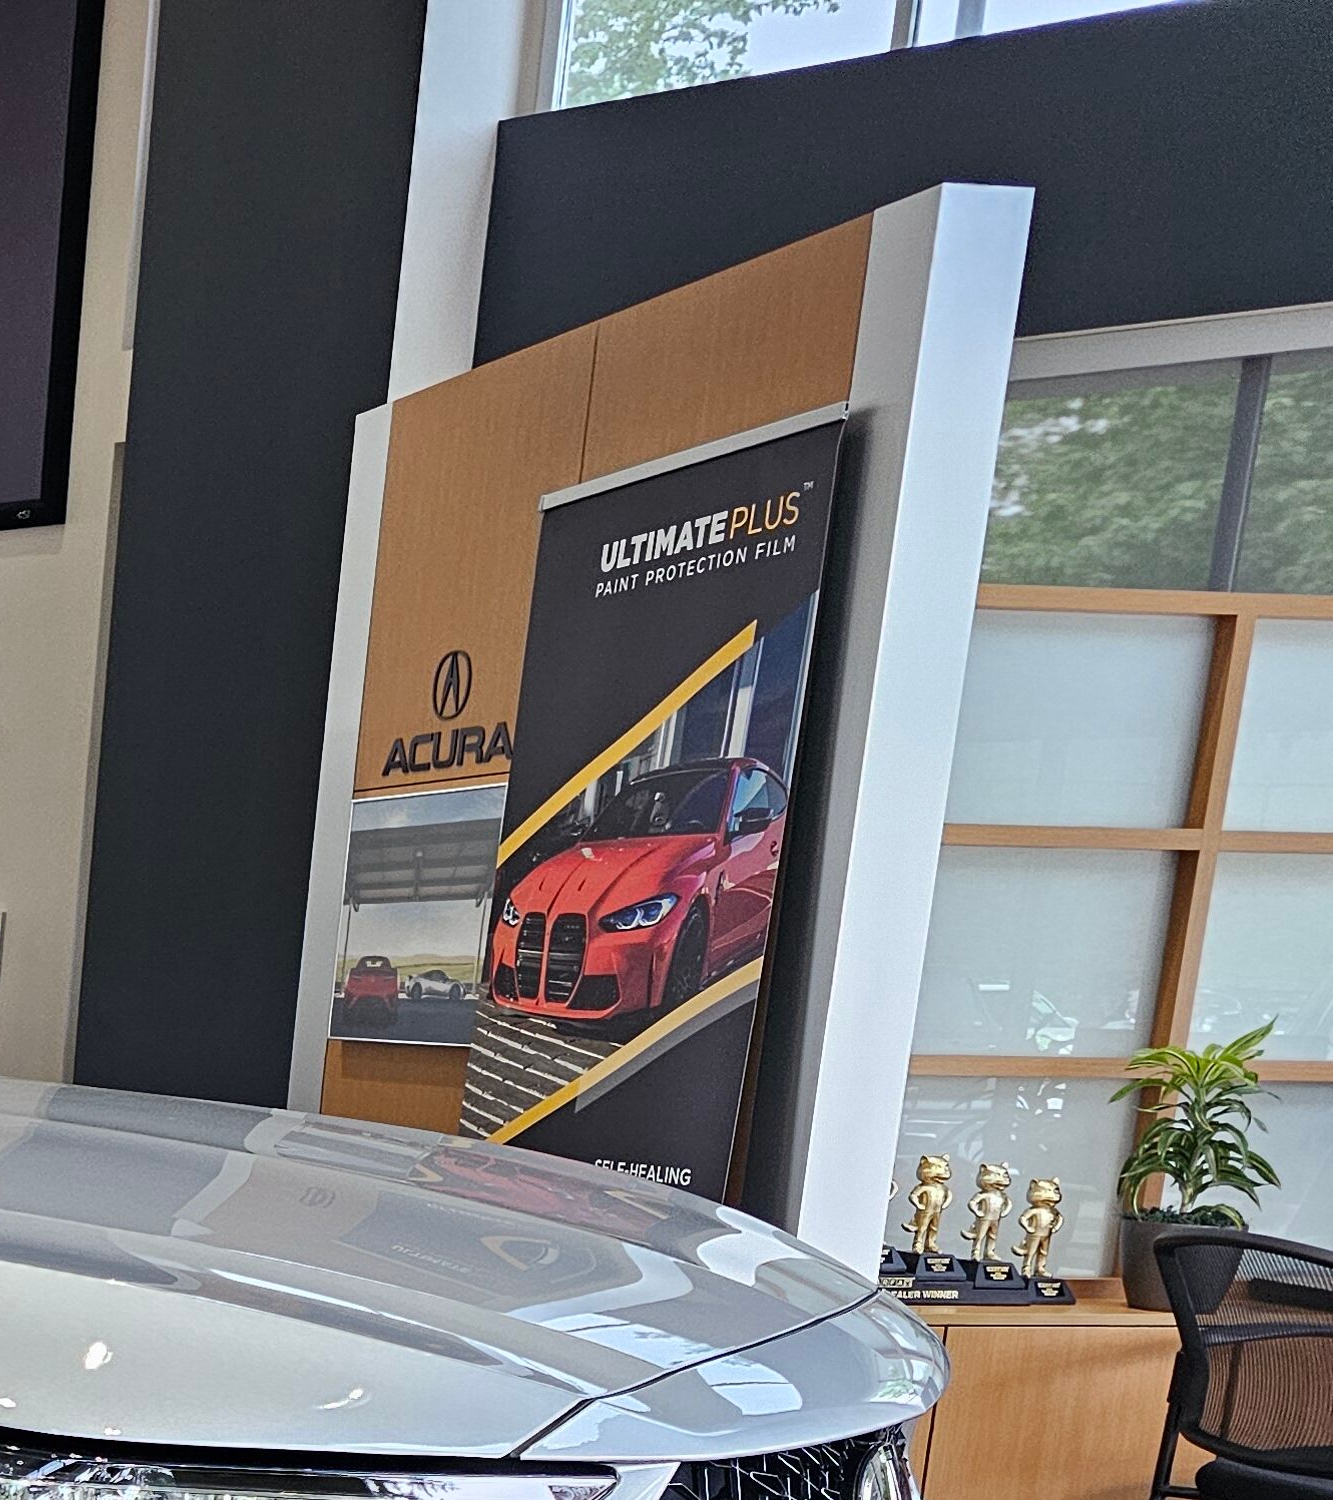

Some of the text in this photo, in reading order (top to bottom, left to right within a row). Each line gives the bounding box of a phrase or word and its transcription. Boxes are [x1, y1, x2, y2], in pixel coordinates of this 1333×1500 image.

[595, 534, 796, 598] PAINT PROTECTION FILM
[381, 721, 514, 776] ACURA
[886, 1290, 959, 1299] EALER WINNER
